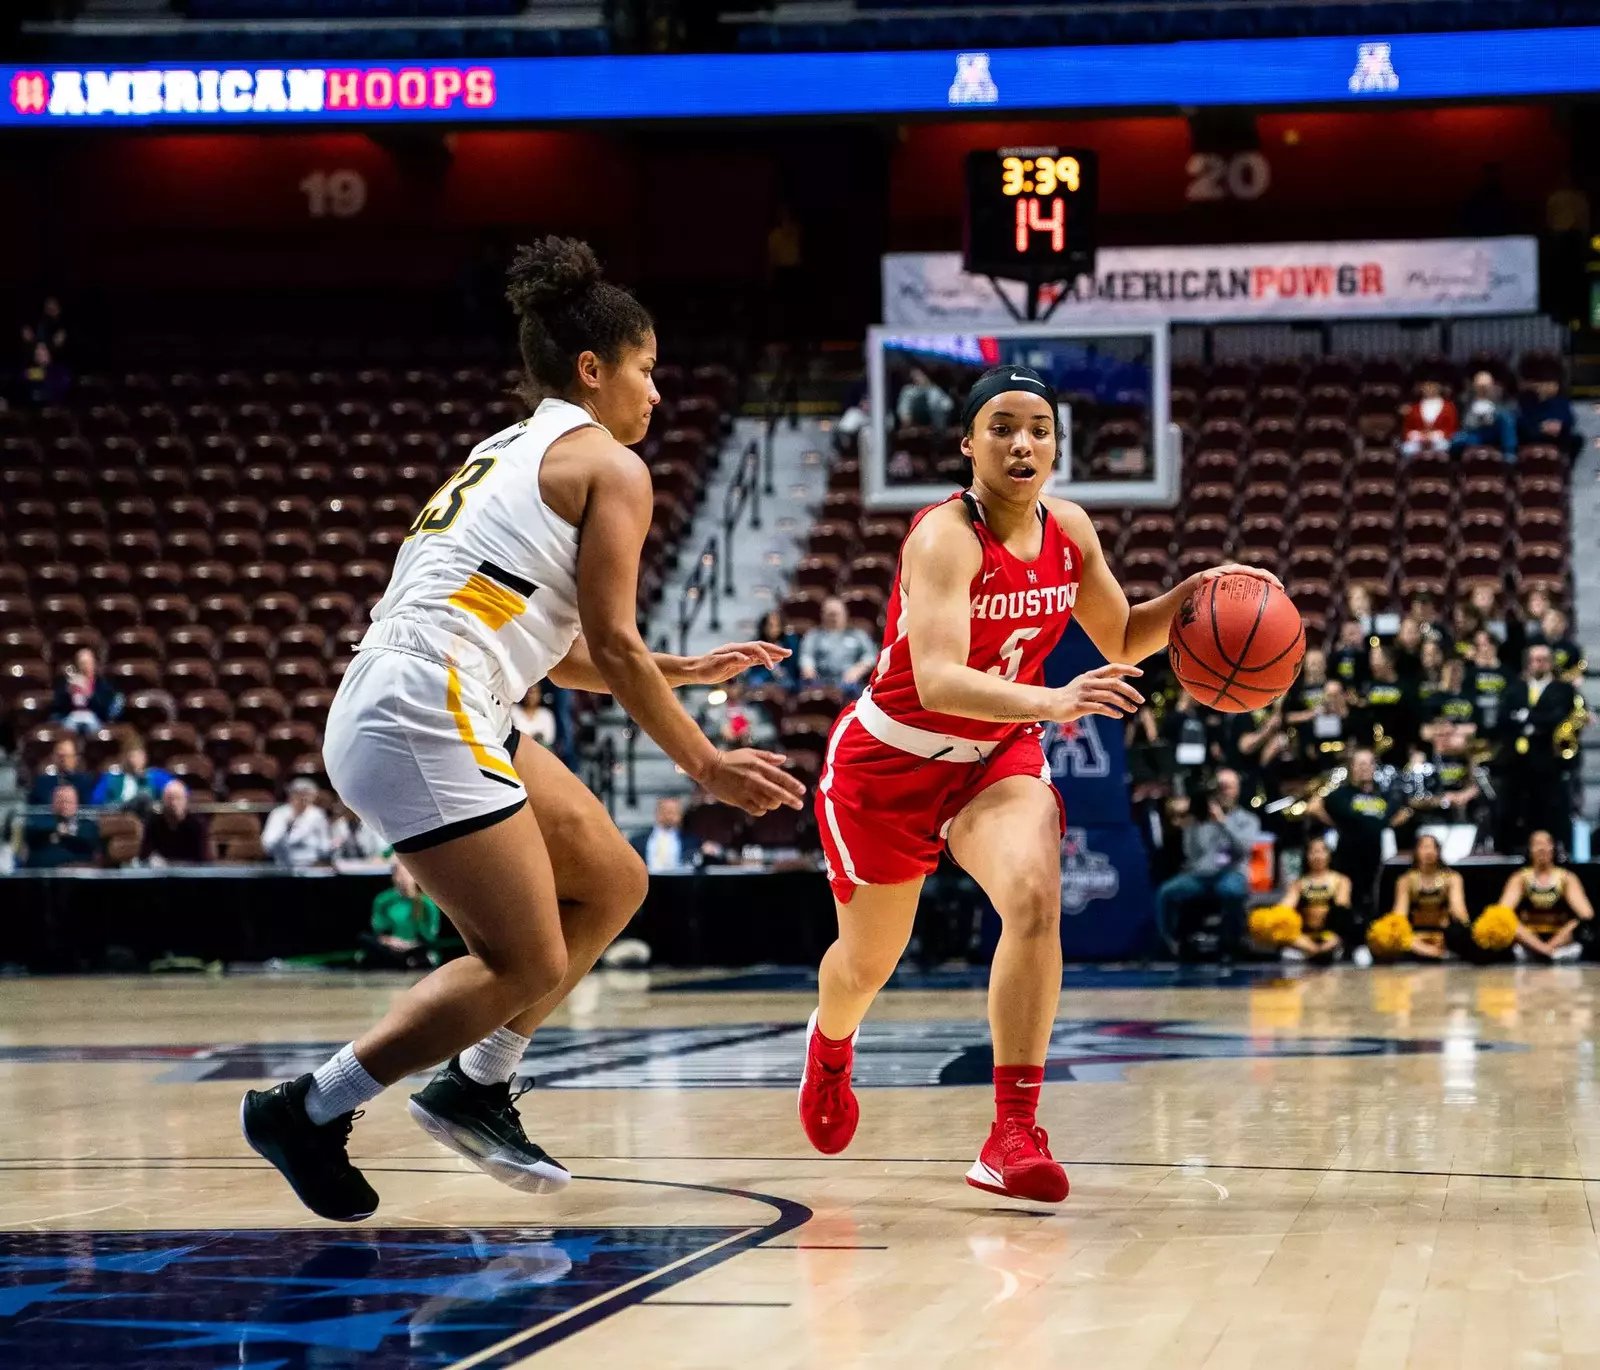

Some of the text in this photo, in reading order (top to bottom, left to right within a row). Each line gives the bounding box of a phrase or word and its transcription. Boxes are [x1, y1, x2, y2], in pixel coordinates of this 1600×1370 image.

[301, 169, 367, 217] 19
[1002, 156, 1080, 196] 3:39
[1185, 151, 1271, 201] 20
[1015, 197, 1064, 252] 14
[970, 582, 1079, 620] HOUSTON
[986, 627, 1043, 683] 5
